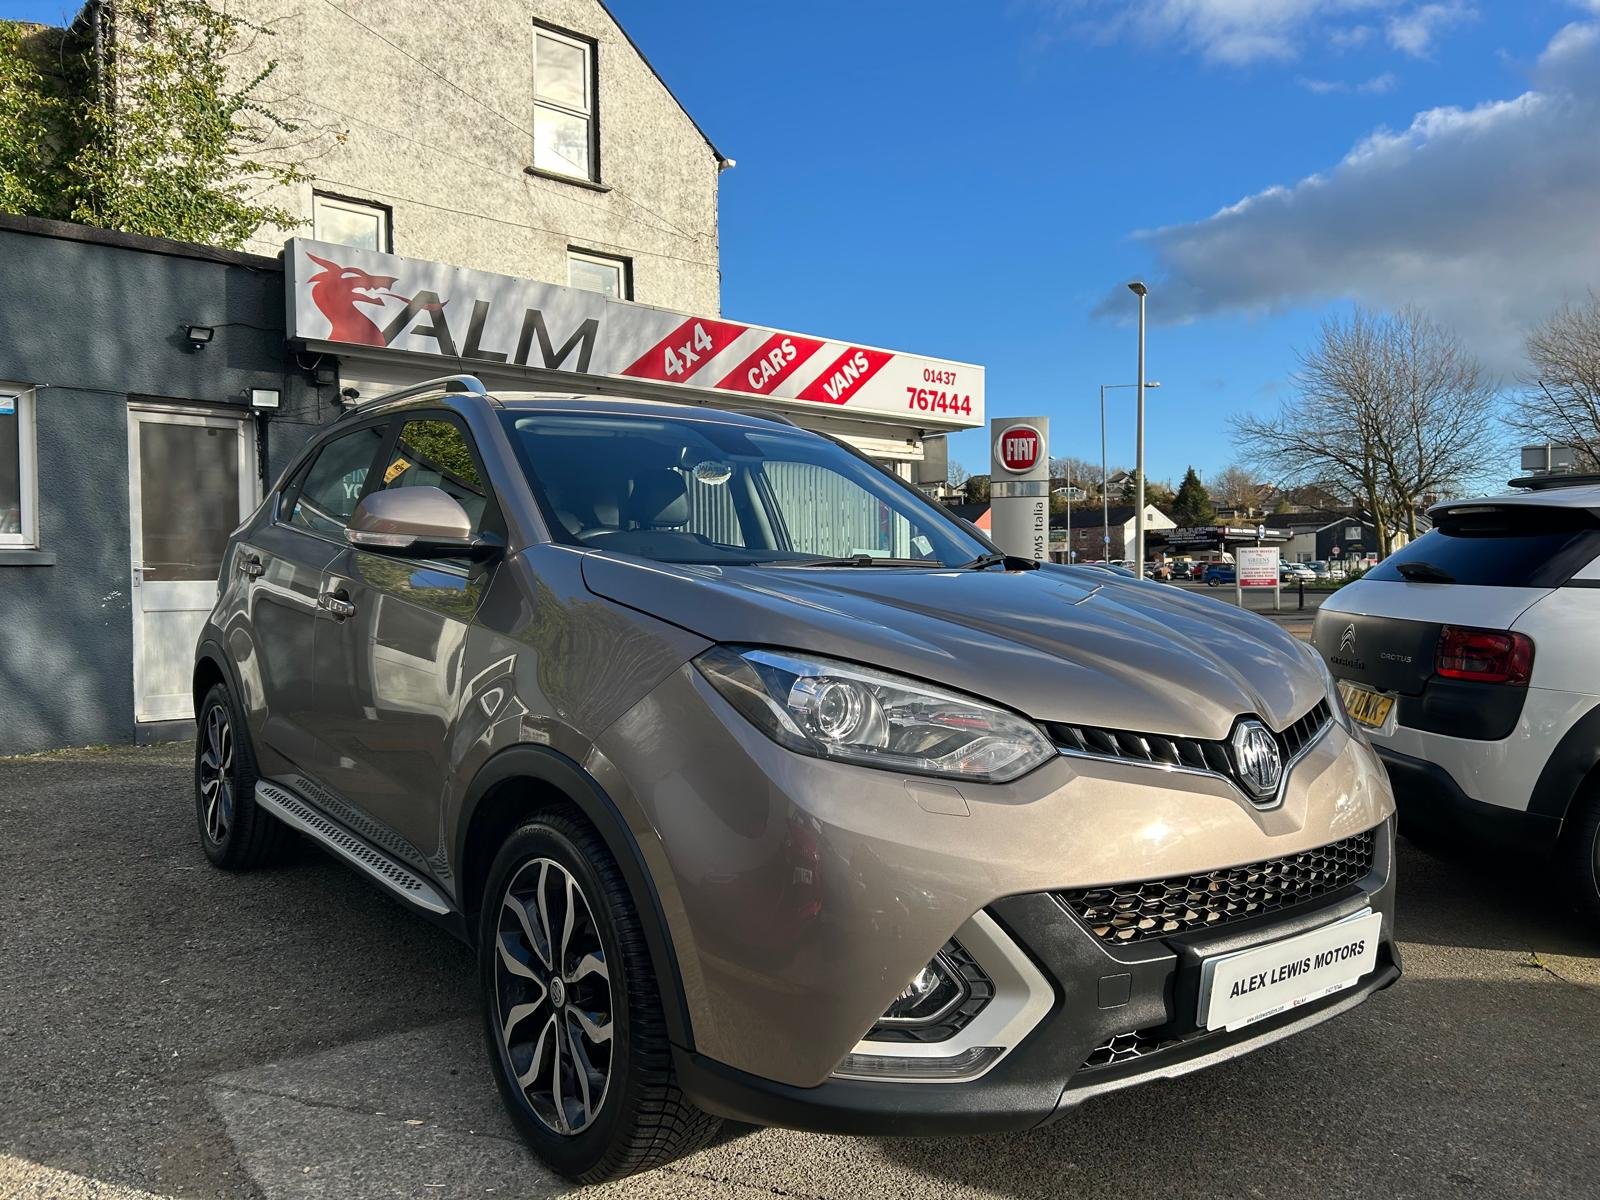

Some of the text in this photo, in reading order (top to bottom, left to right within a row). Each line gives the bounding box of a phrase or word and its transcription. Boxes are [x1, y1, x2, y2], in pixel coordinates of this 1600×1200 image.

[381, 290, 599, 373] ALM
[663, 323, 713, 377] 4x4
[747, 338, 797, 390] CARS
[822, 351, 870, 401] VANS
[923, 368, 957, 386] 01437
[906, 387, 972, 416] 767444
[1006, 437, 1036, 460] FIAT
[1033, 502, 1044, 559] PMS Italia
[1230, 939, 1365, 999] ALEX LEWIS MOTORS
